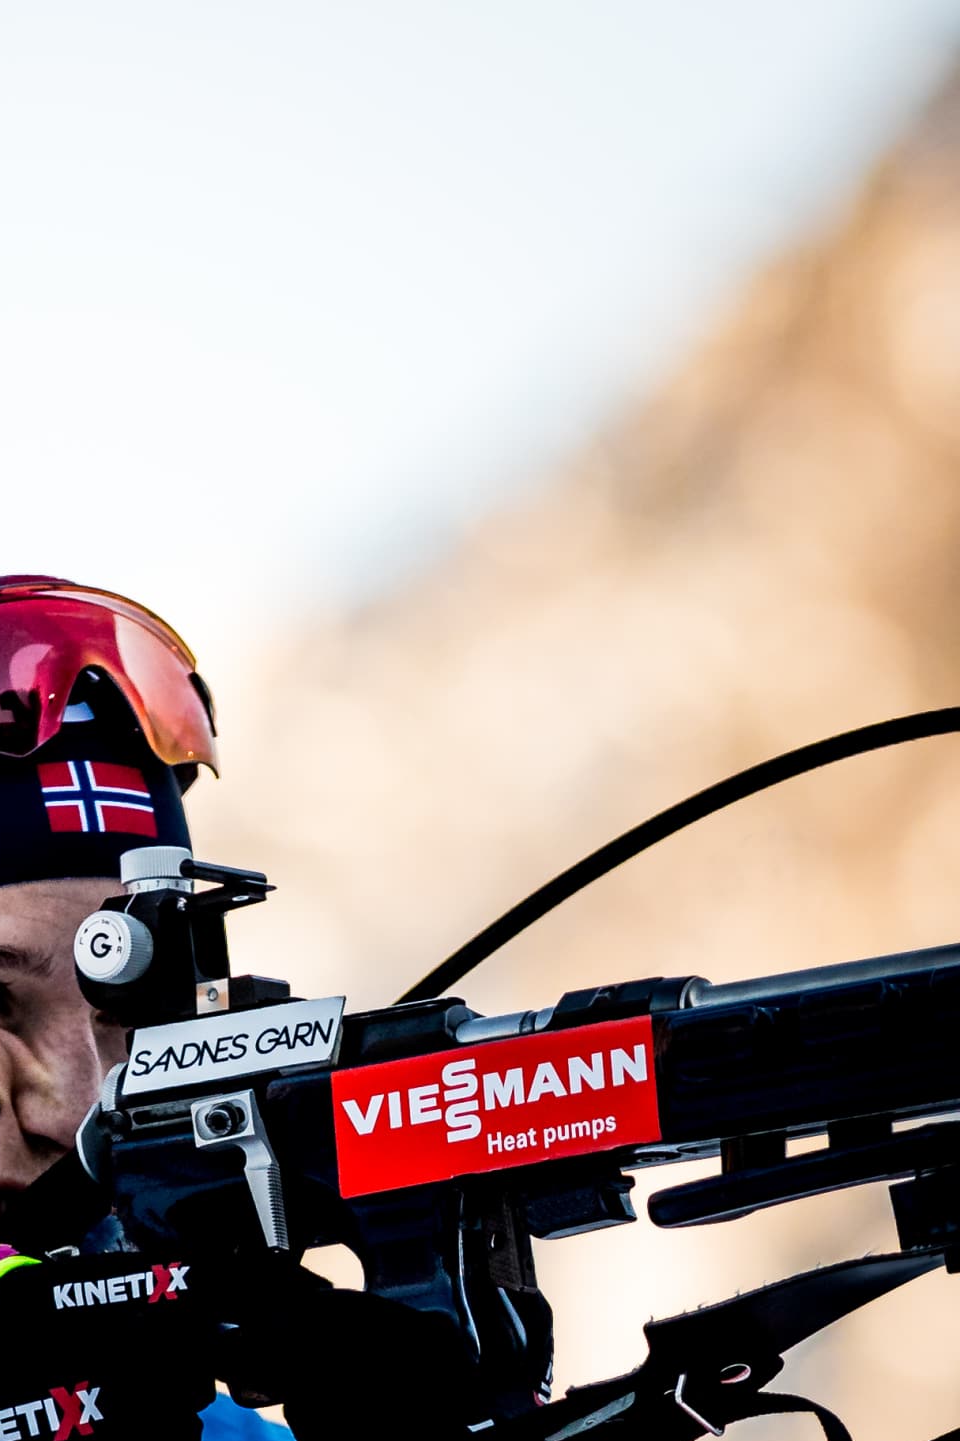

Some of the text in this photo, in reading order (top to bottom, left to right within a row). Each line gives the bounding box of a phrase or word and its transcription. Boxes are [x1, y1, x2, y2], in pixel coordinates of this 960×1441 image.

[90, 932, 113, 959] G
[131, 1018, 334, 1077] SANDNES GARN
[341, 1044, 648, 1143] VIESSMANN
[487, 1115, 617, 1155] Heat pumps
[53, 1262, 190, 1310] KINETIXX
